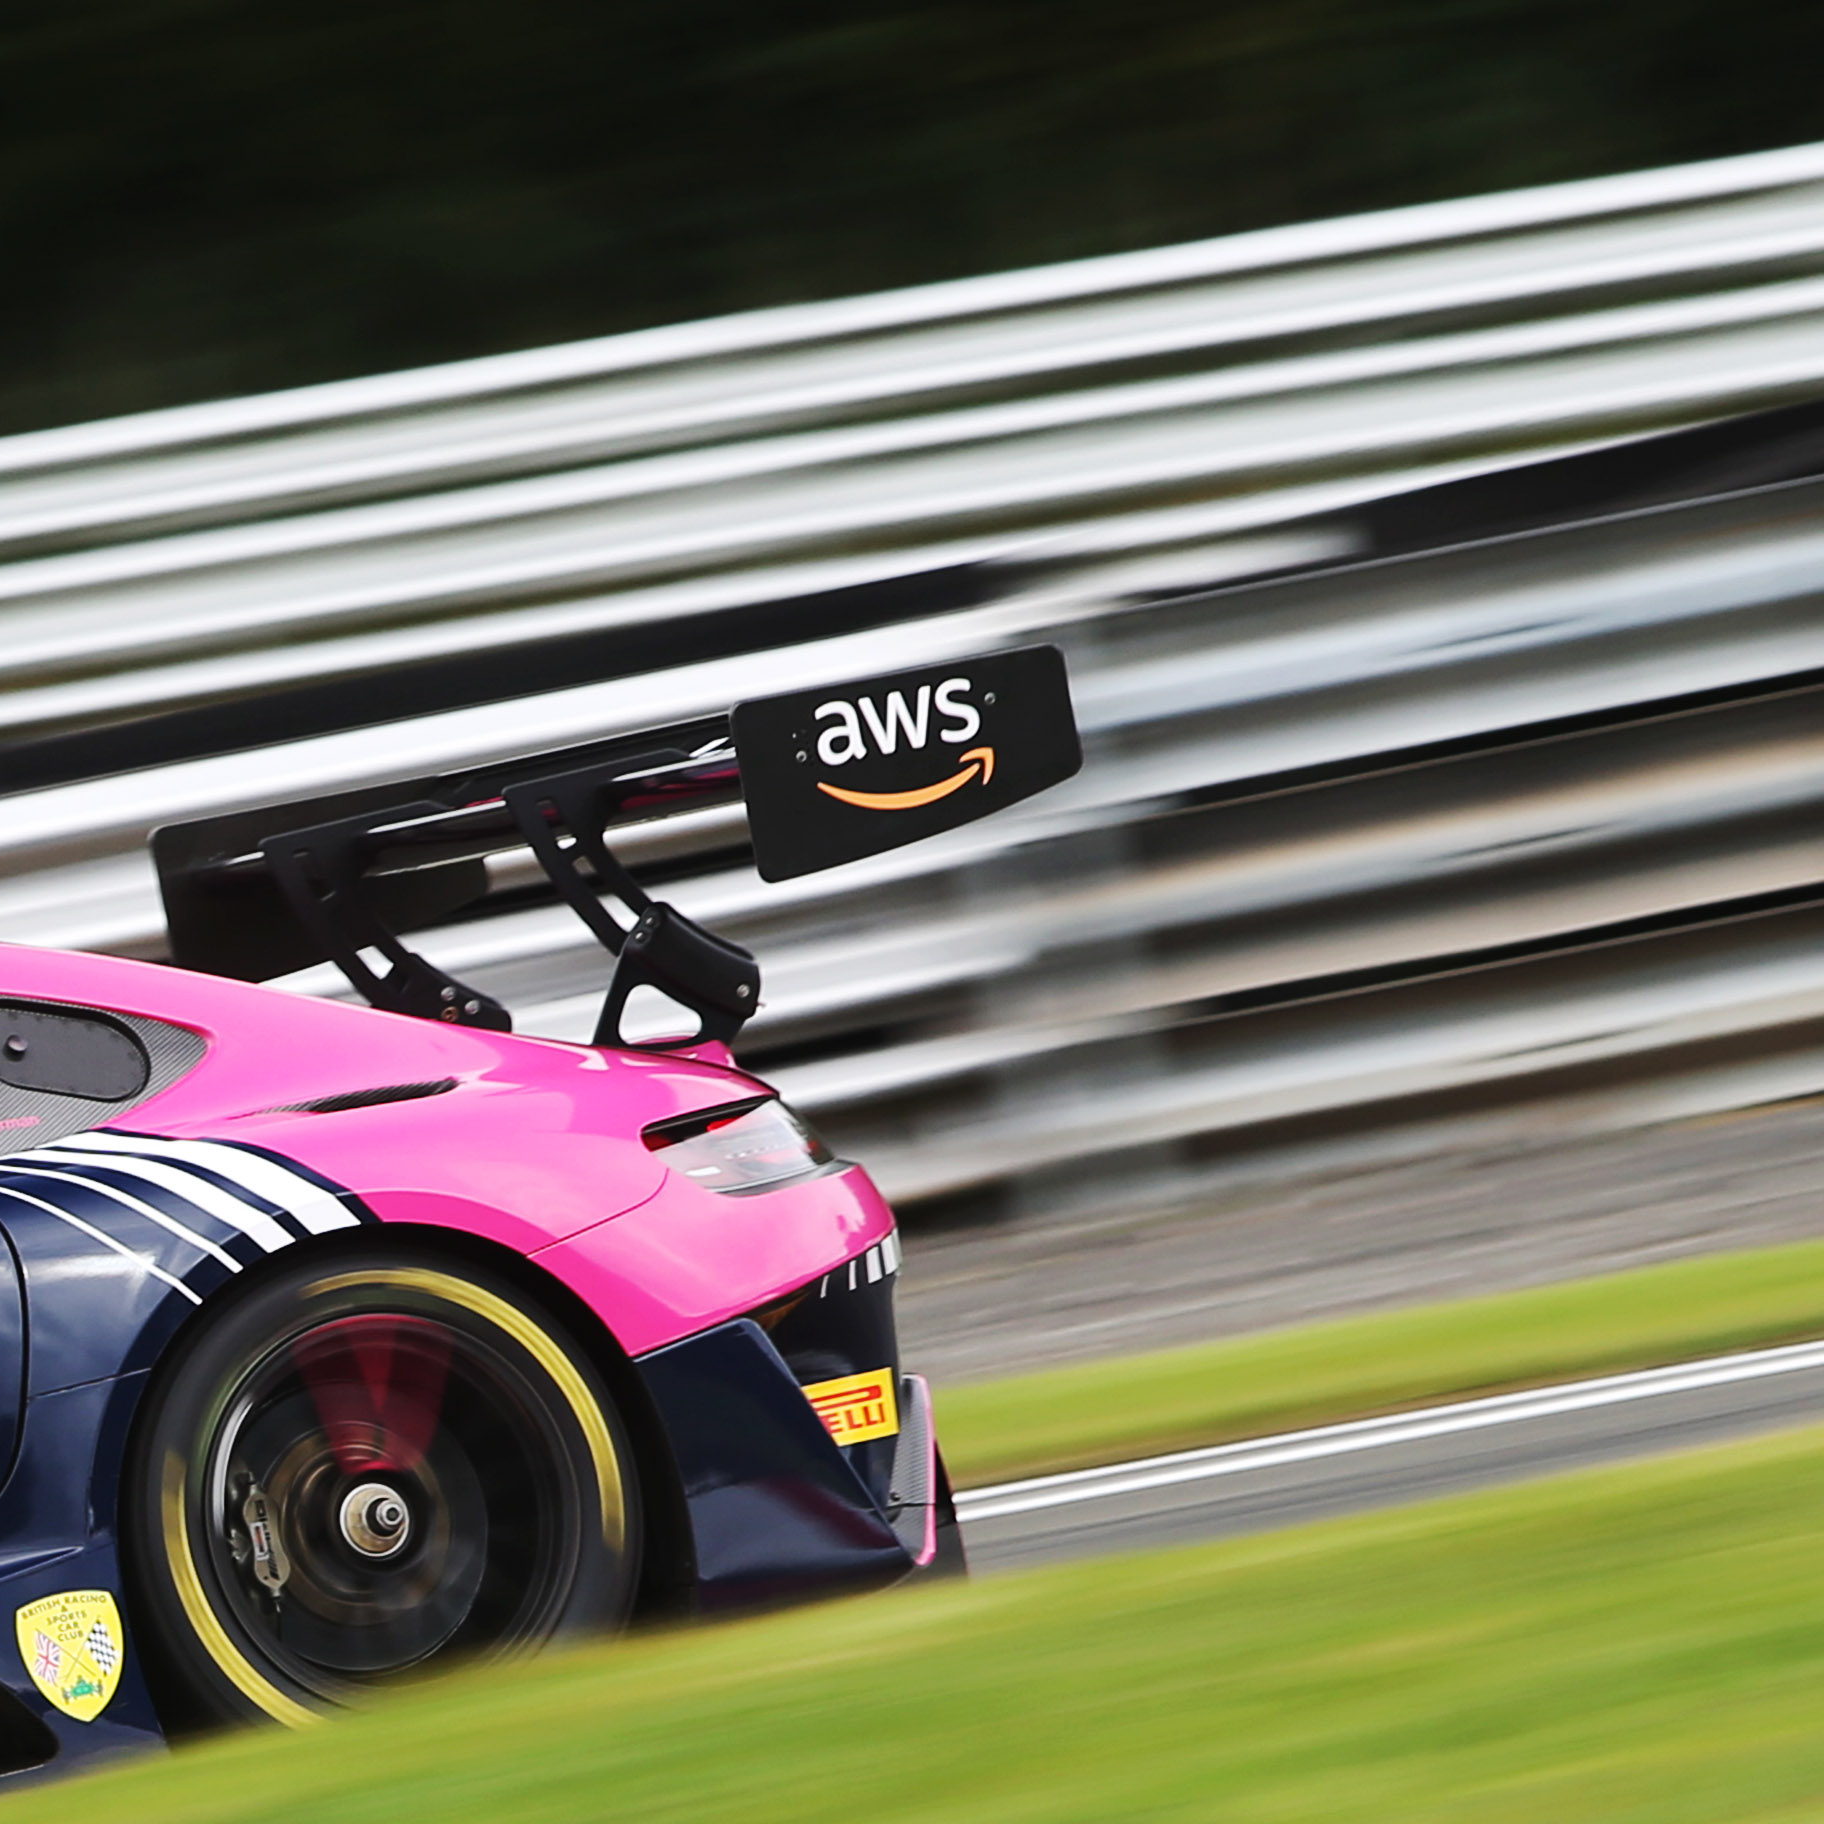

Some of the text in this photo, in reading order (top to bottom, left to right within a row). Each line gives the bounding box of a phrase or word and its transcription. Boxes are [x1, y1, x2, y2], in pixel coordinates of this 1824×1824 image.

[814, 677, 982, 766] aws
[21, 1595, 107, 1620] BRITISH RACING
[46, 1609, 87, 1626] SPORTS
[58, 1621, 80, 1633] CAR
[58, 1630, 84, 1642] CLUB
